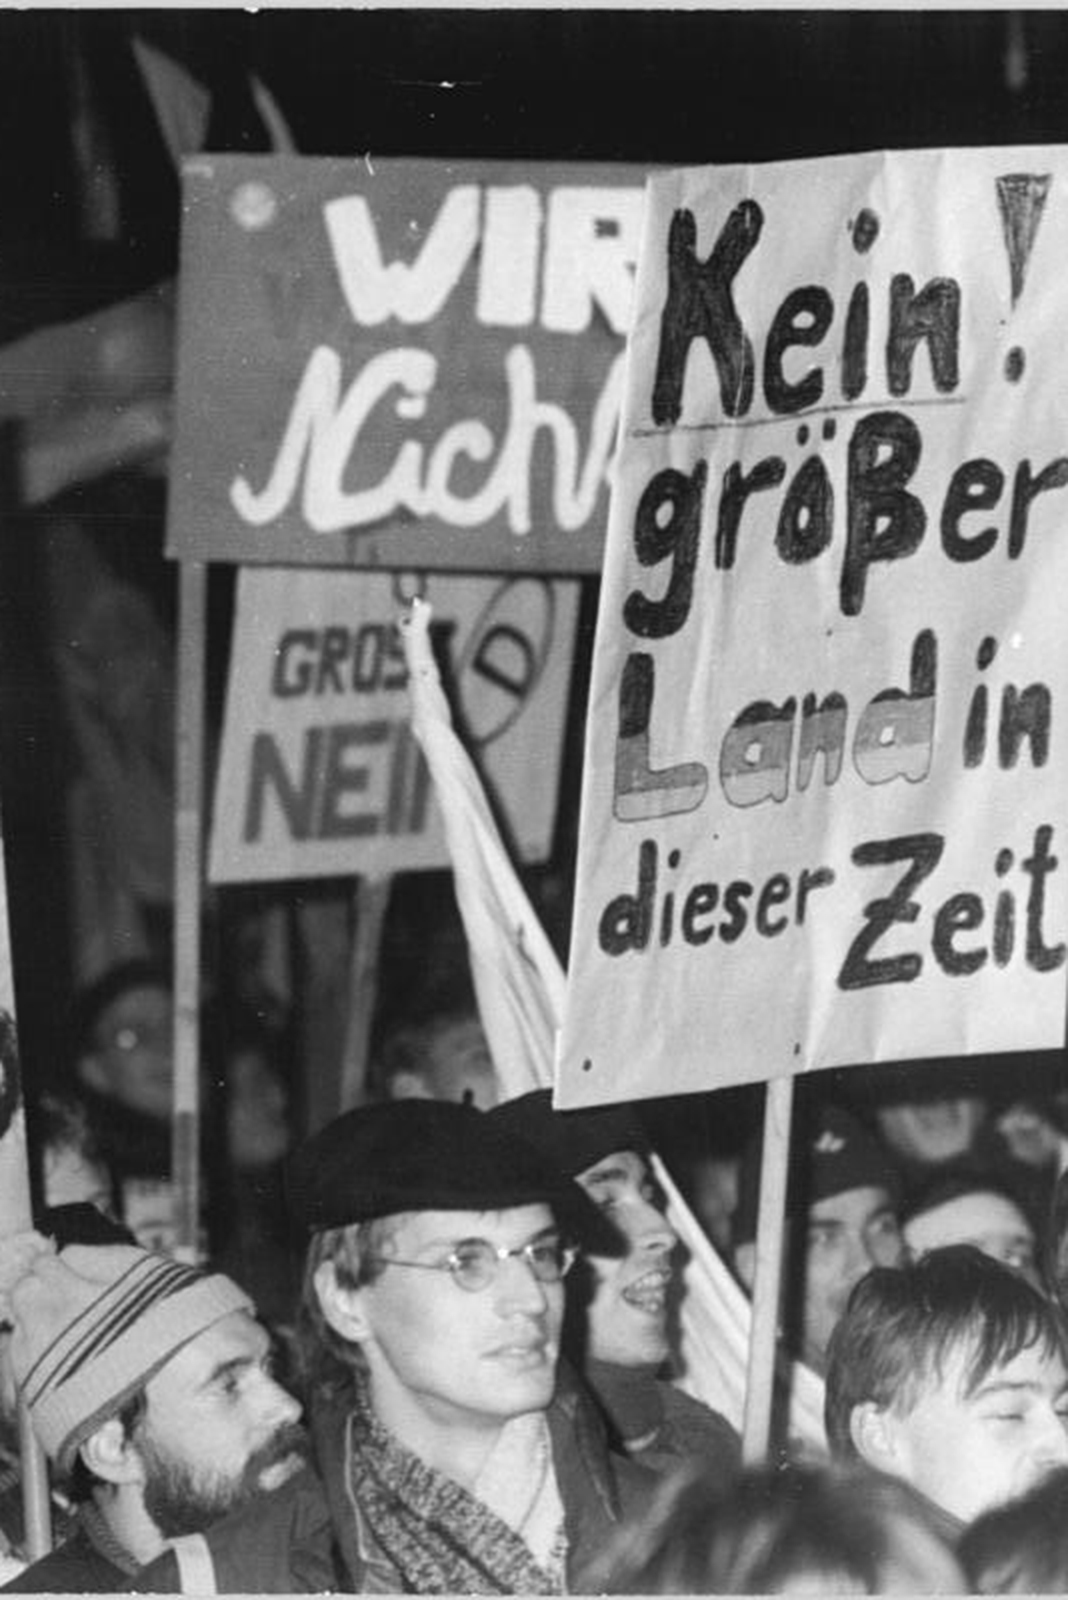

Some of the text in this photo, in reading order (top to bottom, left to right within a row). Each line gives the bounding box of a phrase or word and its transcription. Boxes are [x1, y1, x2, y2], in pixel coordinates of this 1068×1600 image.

[323, 184, 642, 334] WIR
[613, 629, 1052, 823] Land in
[598, 825, 1067, 991] dieser Zeit
